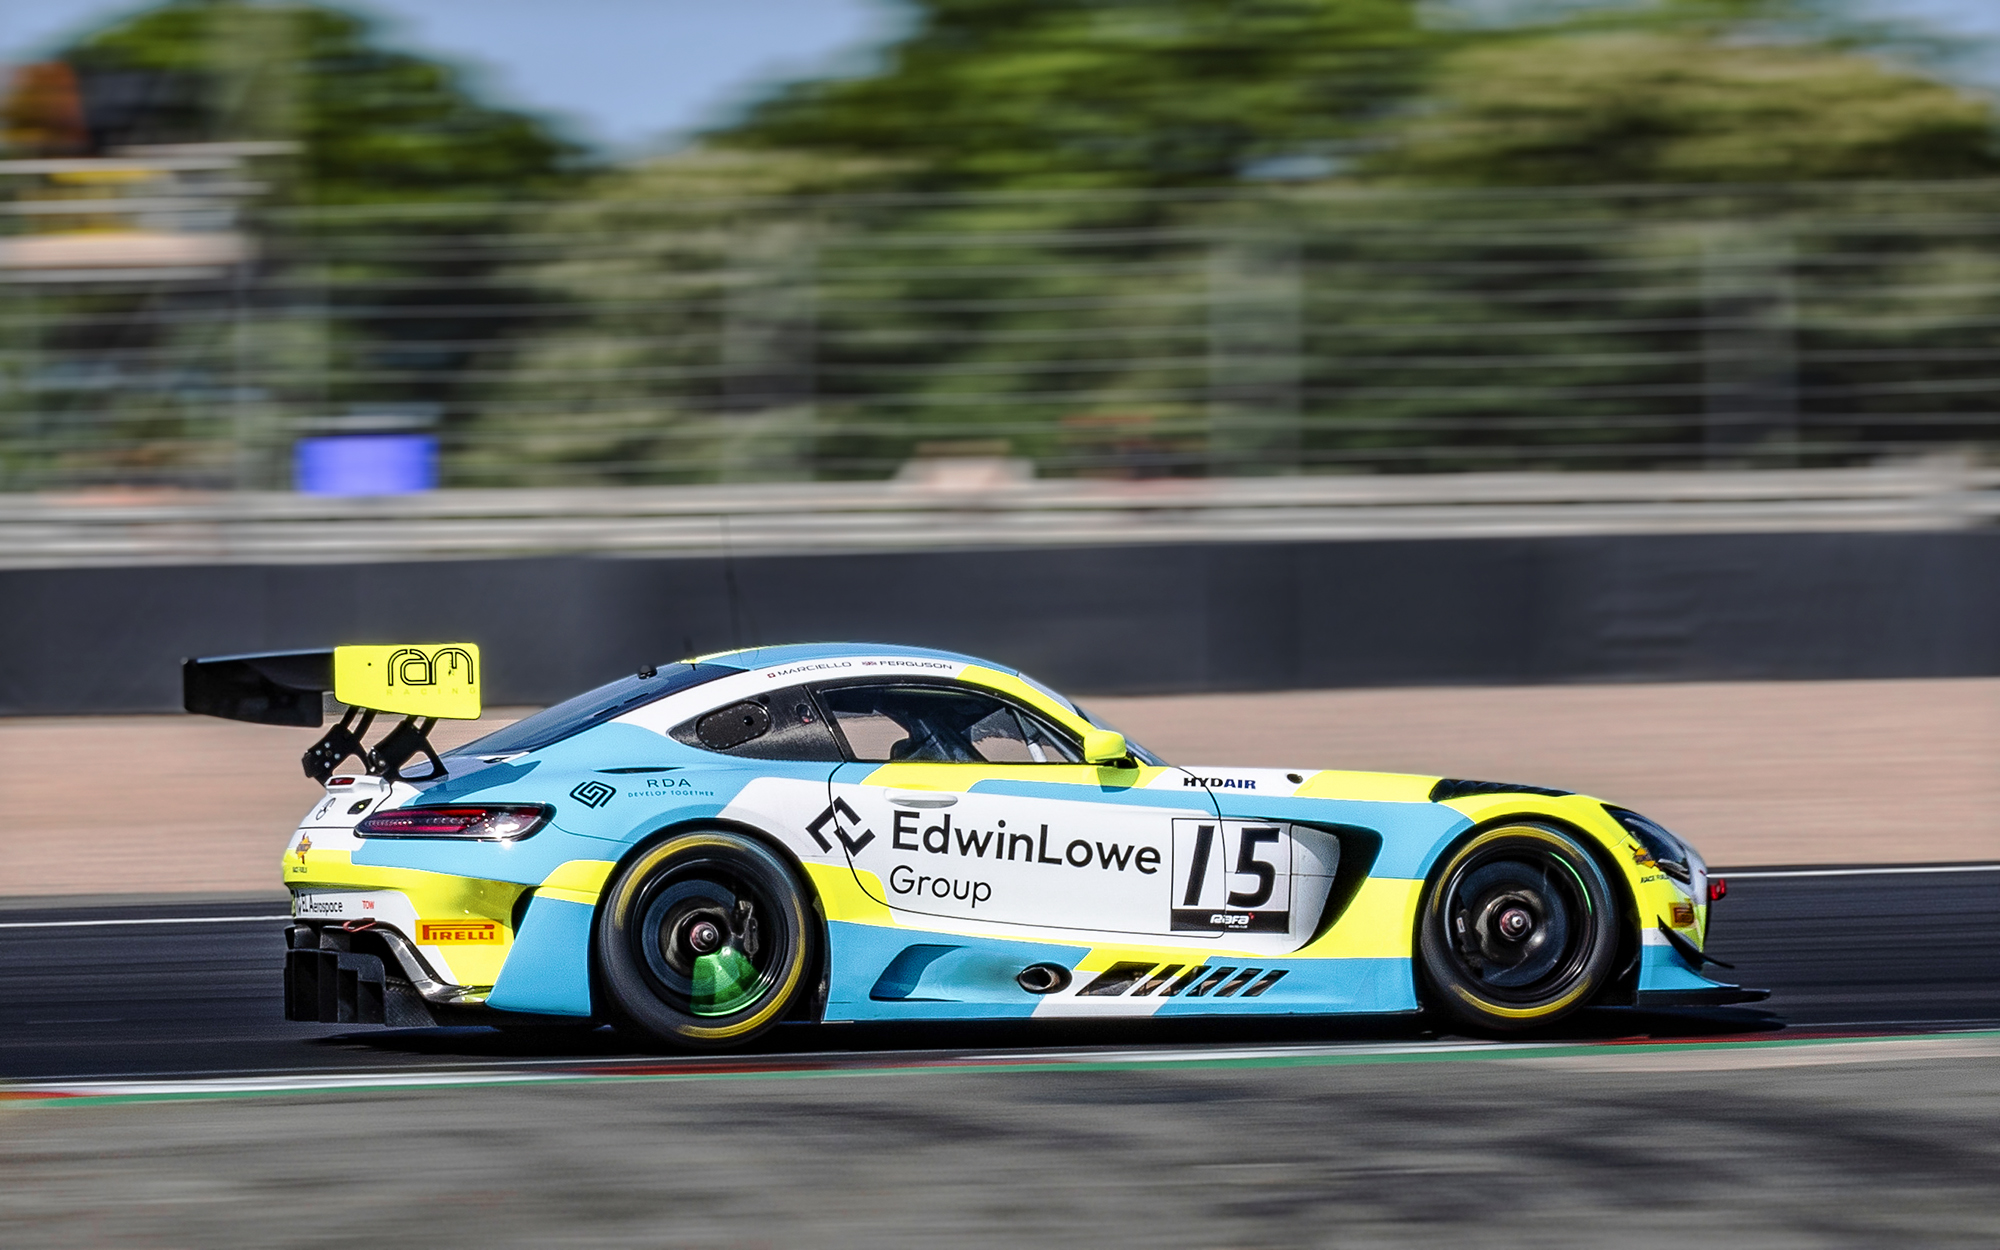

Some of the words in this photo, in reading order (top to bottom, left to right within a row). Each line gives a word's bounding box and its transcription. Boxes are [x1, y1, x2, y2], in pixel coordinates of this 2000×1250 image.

[388, 647, 474, 686] ram
[777, 661, 852, 677] MARCIELLO
[879, 660, 953, 670] FERGUSON
[646, 778, 692, 788] RDA
[1183, 777, 1257, 790] HYDAIR
[627, 790, 667, 798] DEVELOP
[892, 809, 1162, 875] EdwinLowe
[1183, 825, 1281, 909] 15
[889, 864, 992, 908] Group
[362, 900, 375, 909] TOW
[422, 924, 495, 941] PIRELLI
